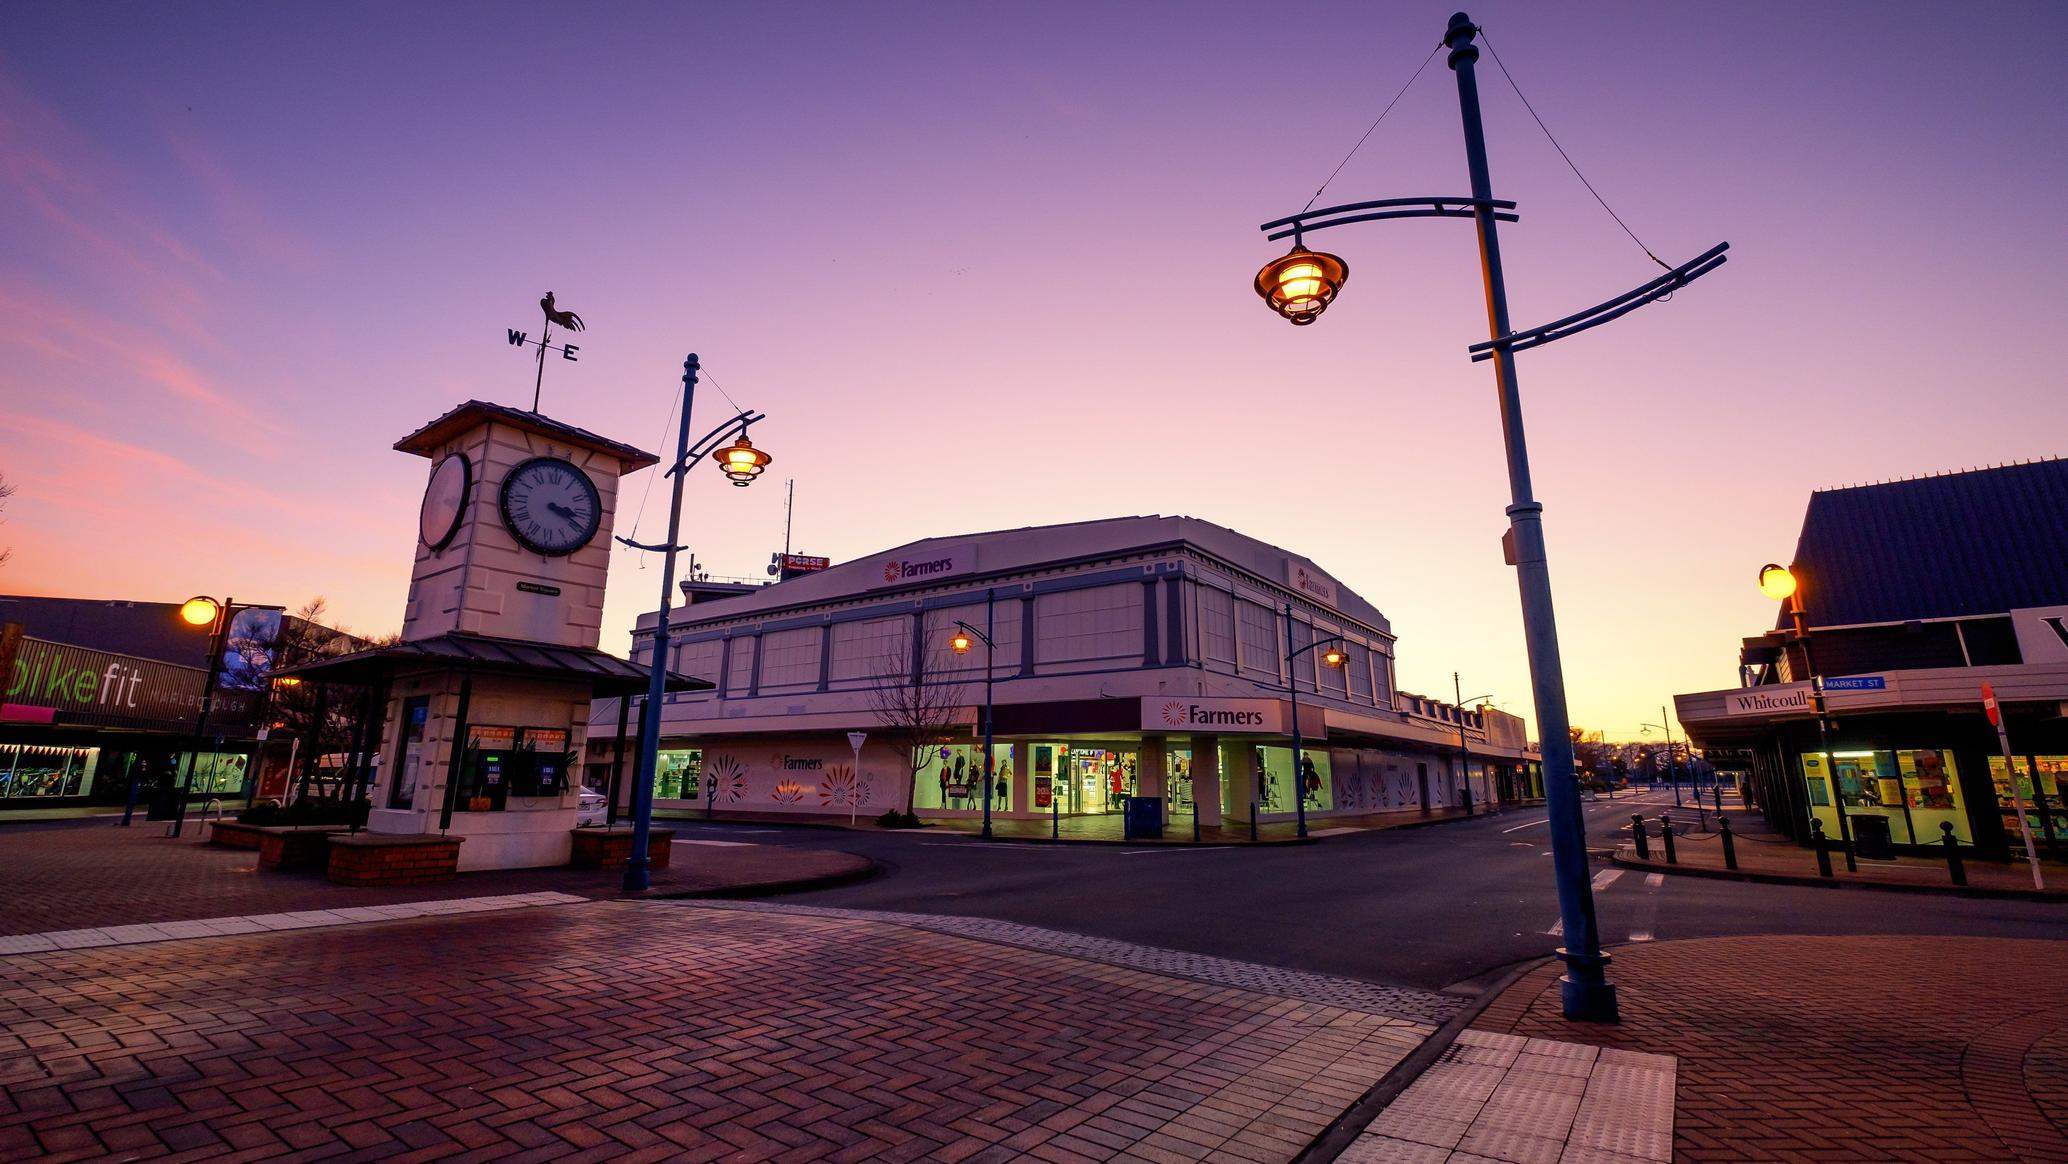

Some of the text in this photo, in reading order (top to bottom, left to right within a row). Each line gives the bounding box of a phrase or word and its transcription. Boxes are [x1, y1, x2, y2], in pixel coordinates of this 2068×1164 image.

[507, 328, 527, 347] W
[563, 343, 579, 362] E
[901, 558, 953, 578] Farmers
[1825, 679, 1880, 688] MARKET ST
[151, 689, 246, 713] MARLBOOUGH
[1736, 690, 1807, 710] Whitcoull
[1189, 704, 1263, 725] Farmers
[783, 754, 823, 770] Farmers
